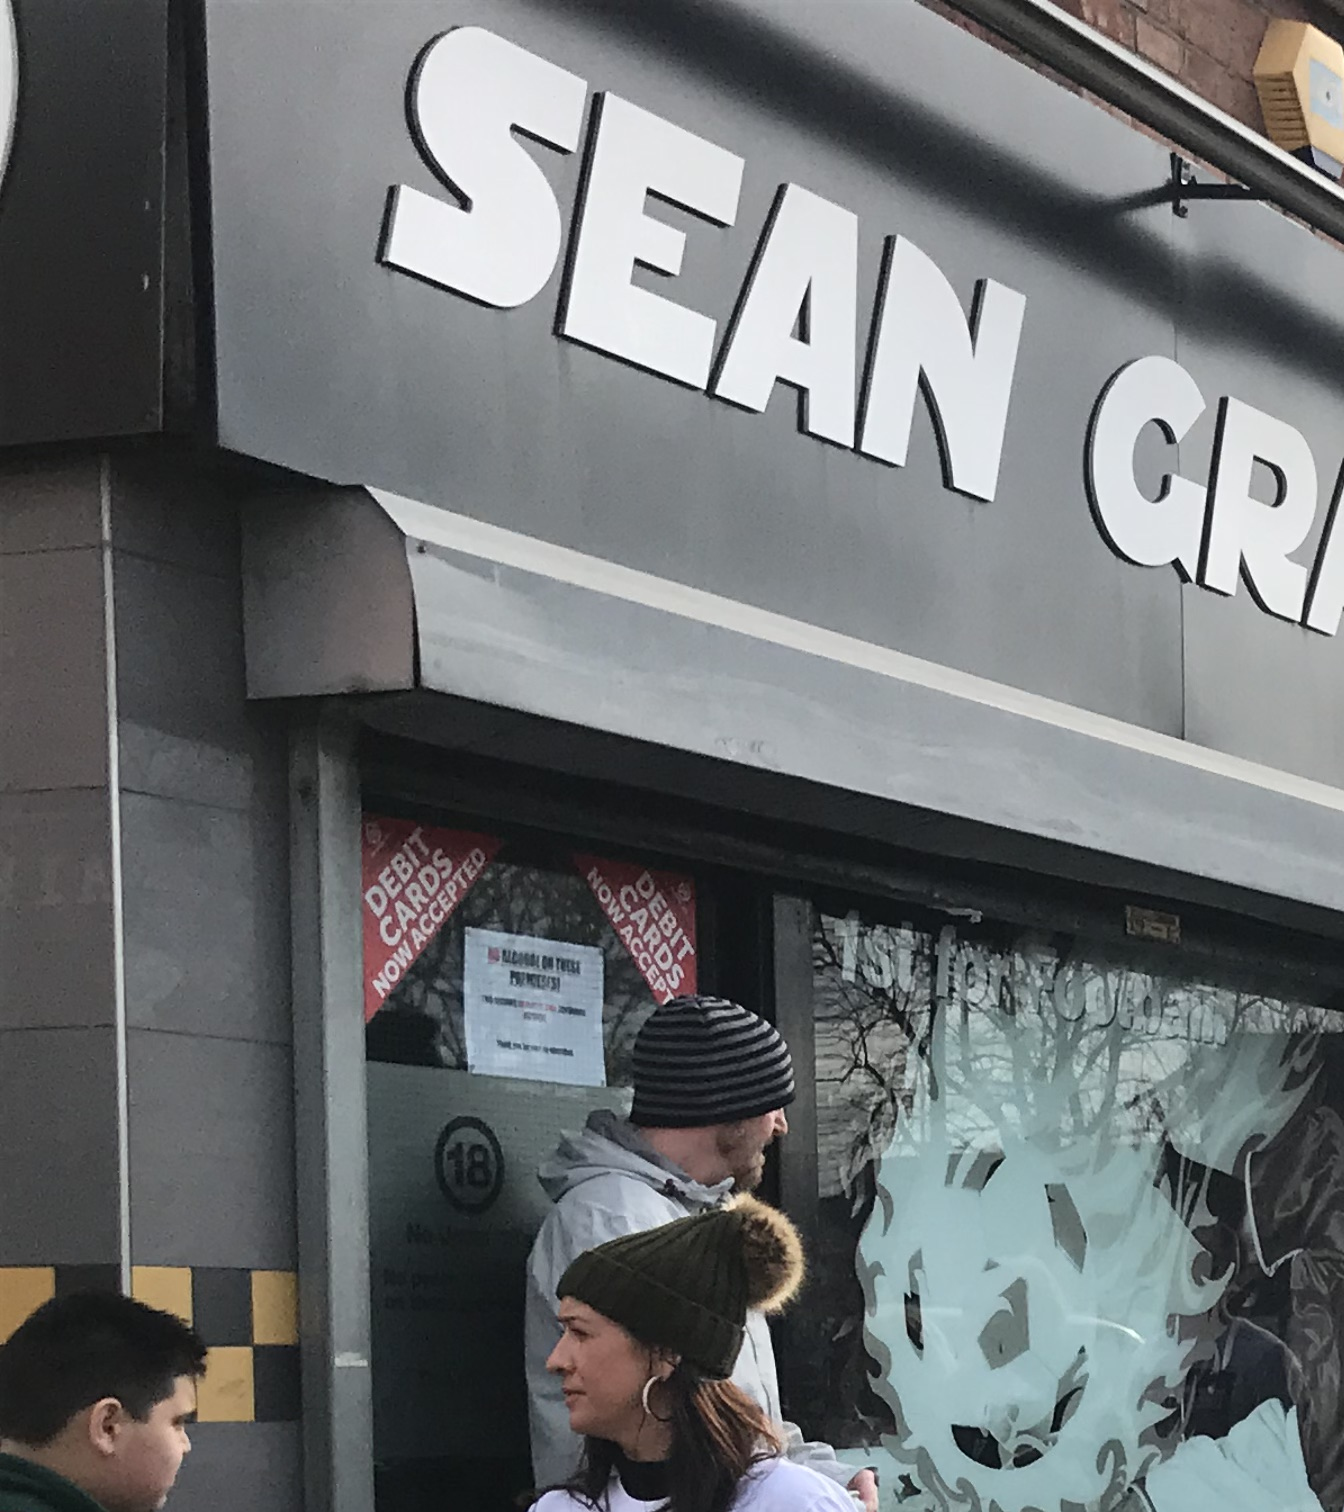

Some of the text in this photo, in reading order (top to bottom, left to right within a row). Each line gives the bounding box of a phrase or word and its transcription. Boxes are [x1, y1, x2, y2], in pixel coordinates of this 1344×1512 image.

[378, 24, 1027, 503] SEAN
[364, 826, 430, 918] DEBIT
[379, 848, 453, 947] CARDS
[635, 870, 696, 960] DEBIT
[371, 848, 487, 999] NOW ACCEPTED
[586, 866, 675, 1005] NOW ACCEPT
[619, 884, 685, 990] CARDS
[447, 1142, 491, 1188] 18
